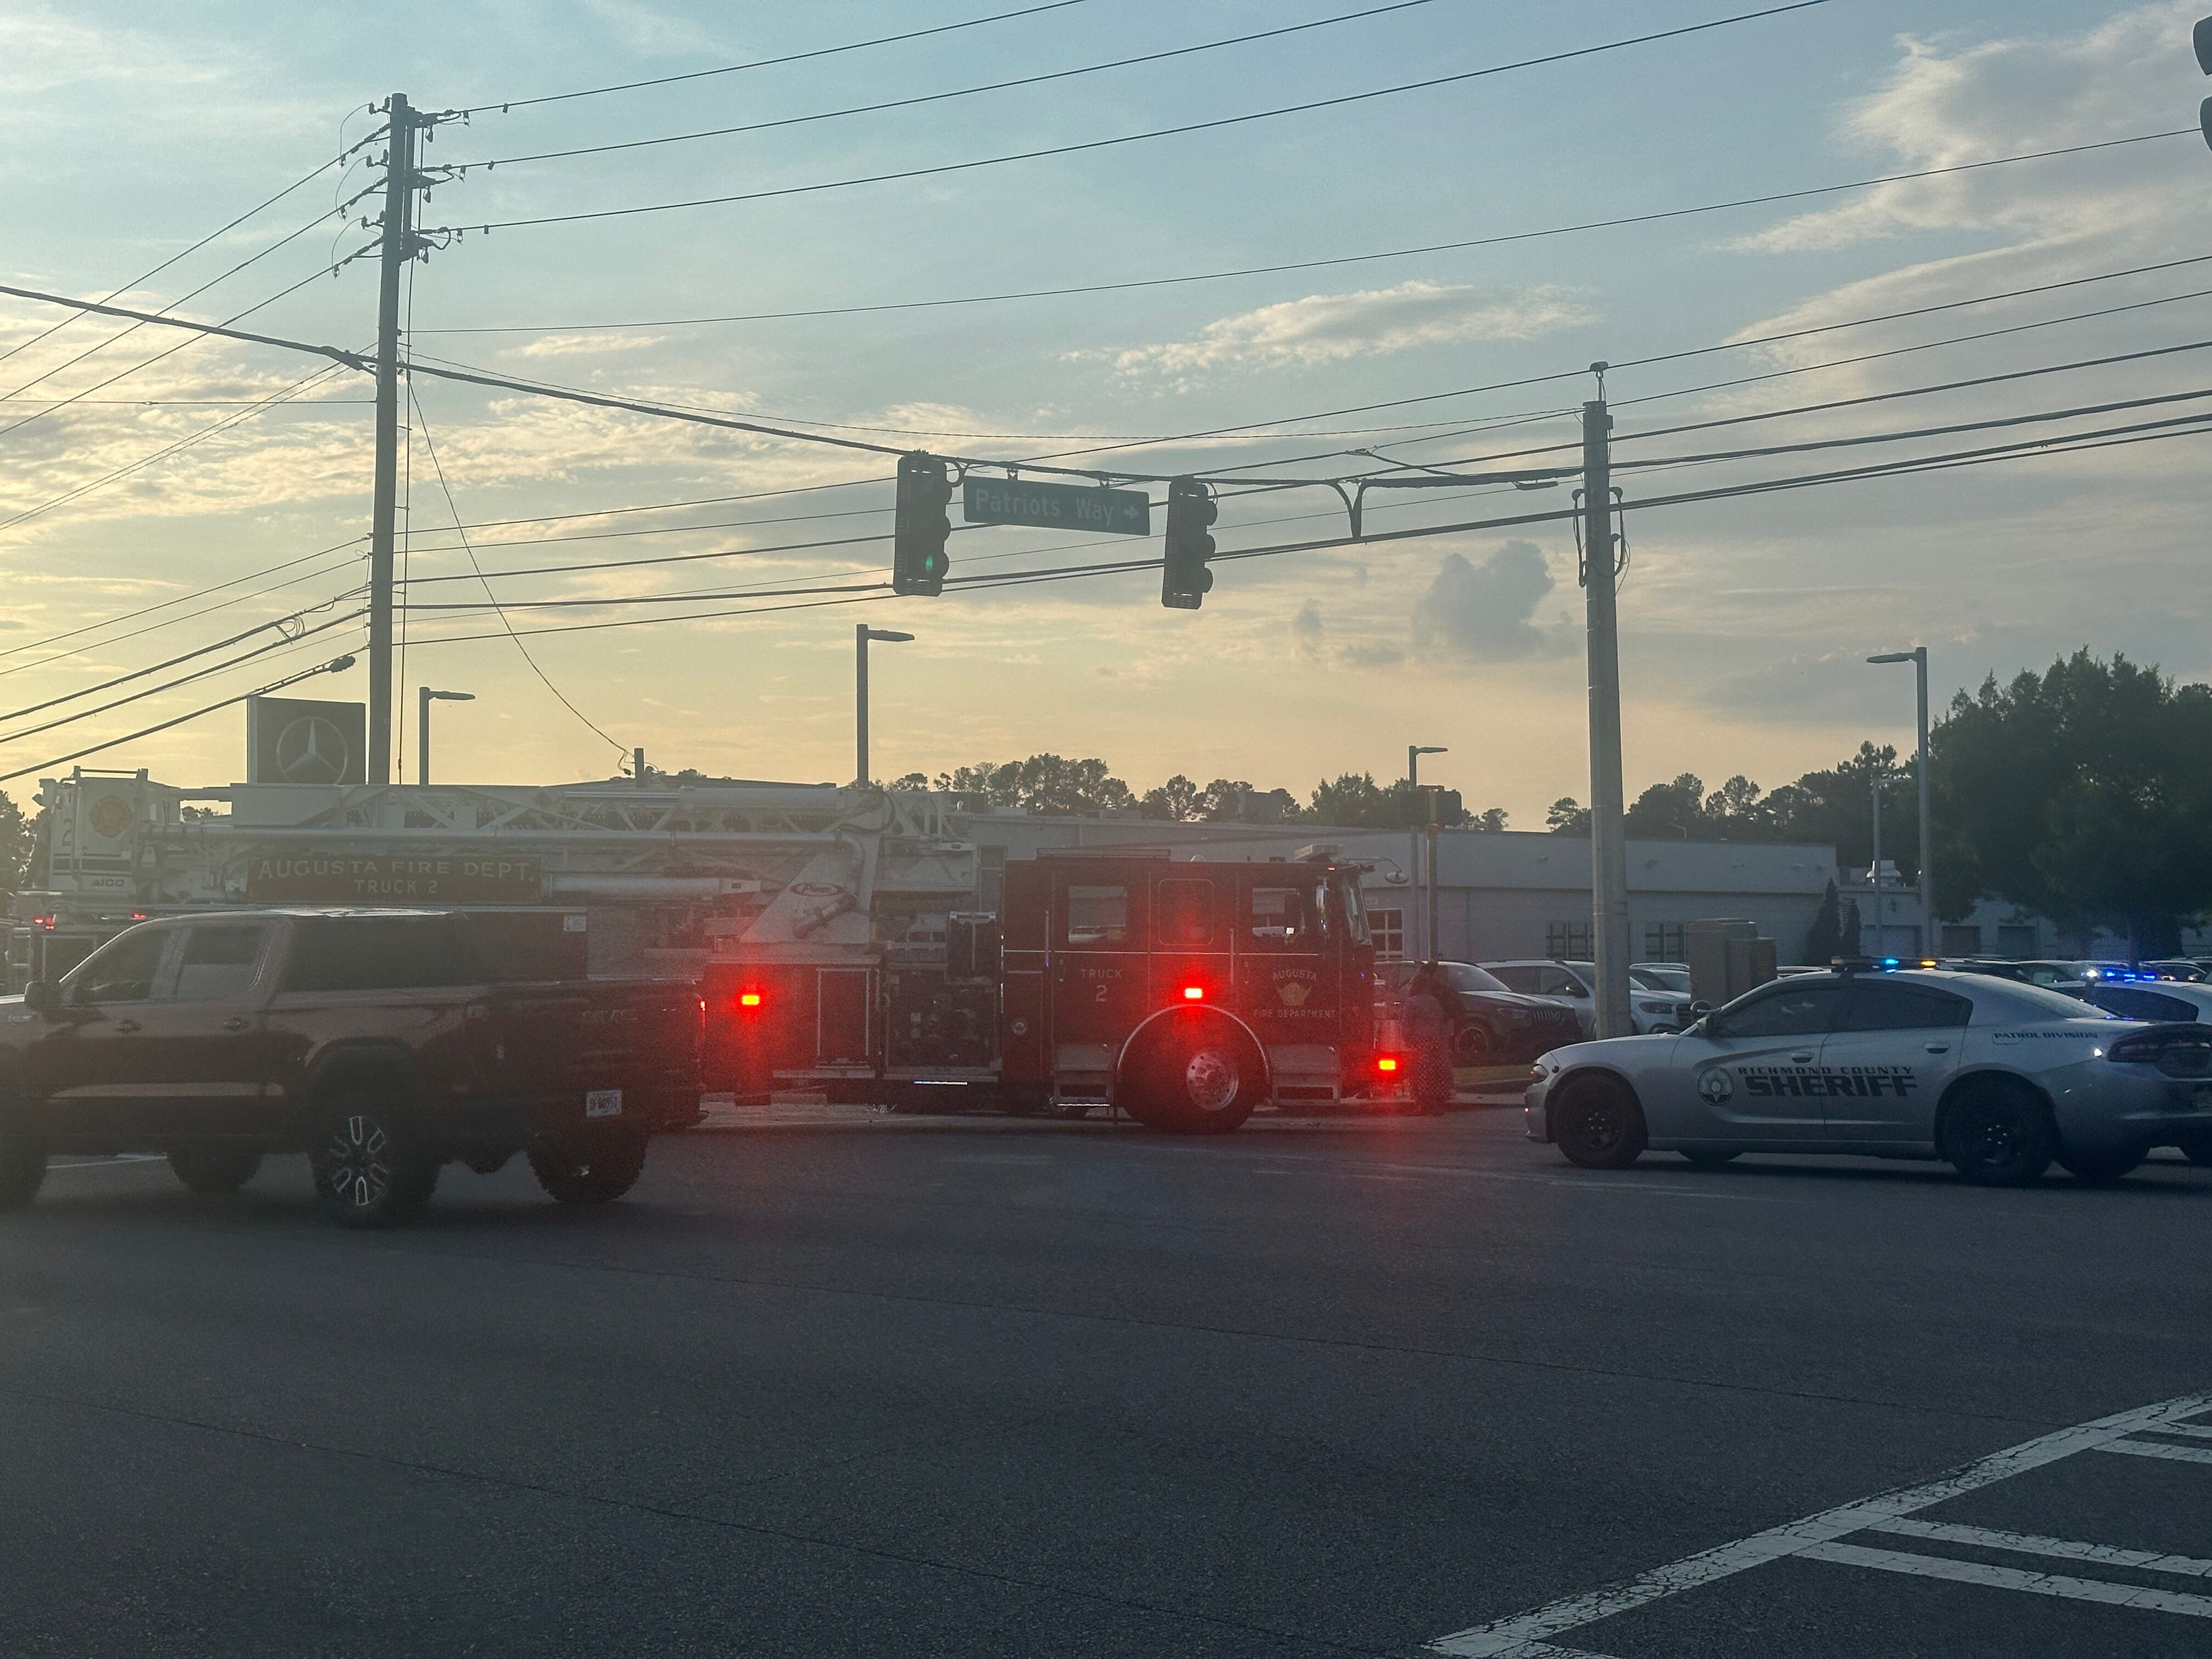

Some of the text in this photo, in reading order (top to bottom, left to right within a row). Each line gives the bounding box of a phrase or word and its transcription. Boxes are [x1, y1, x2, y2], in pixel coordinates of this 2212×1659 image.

[975, 489, 1114, 527] Patriots Way
[257, 860, 534, 882] AUGUSTA FIRE DEPT.
[354, 879, 438, 893] TRUCK 2
[1080, 968, 1122, 979] TRUCK
[1273, 969, 1317, 982] AUGUSTA
[1095, 985, 1107, 1002] 2
[1254, 1008, 1273, 1019] FIRE
[1278, 1008, 1336, 1019] DEPARTMENT
[1737, 1066, 1912, 1075] RICHMOND COUNTY
[1744, 1075, 1918, 1097] SHERIFF
